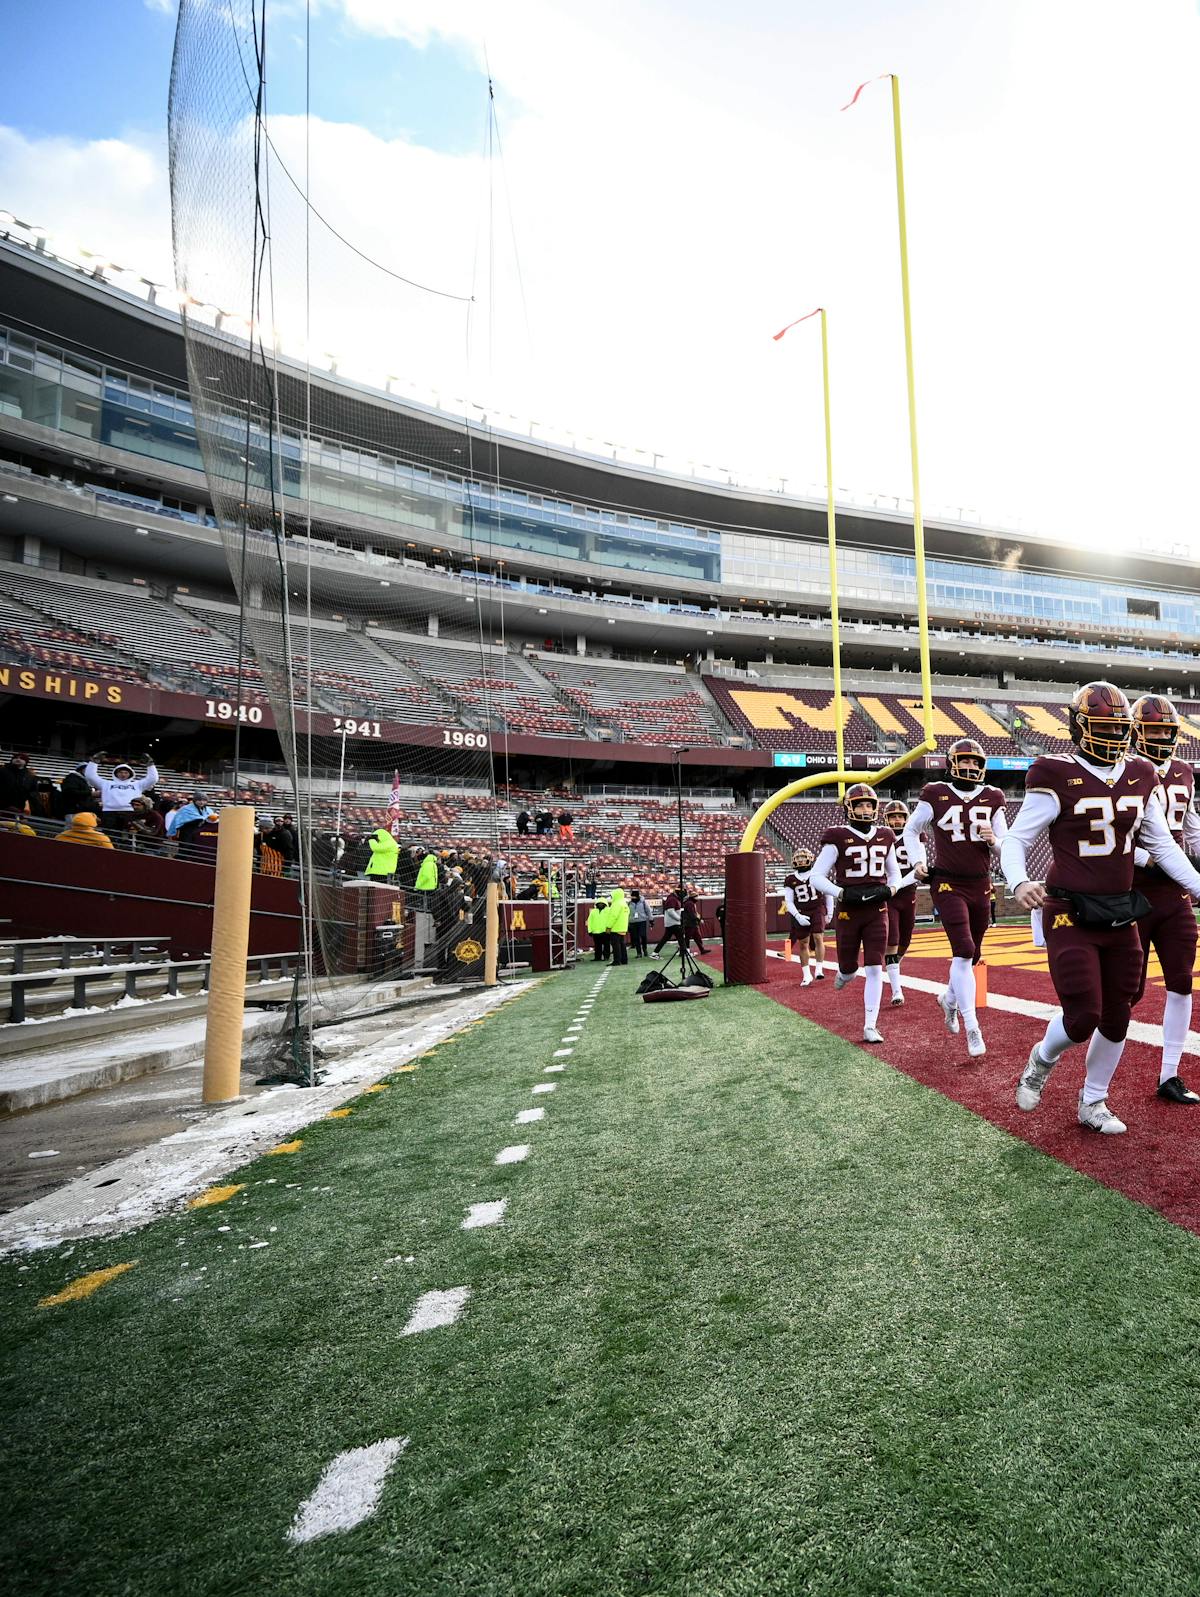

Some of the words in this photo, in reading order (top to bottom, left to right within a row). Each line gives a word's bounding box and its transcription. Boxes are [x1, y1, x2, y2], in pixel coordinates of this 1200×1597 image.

[974, 611, 1051, 627] UNIVERSITY
[1058, 620, 1073, 628] OF
[1079, 623, 1145, 636] MINNESOTA
[205, 700, 263, 724] 1940
[333, 718, 382, 738] 1941
[442, 730, 488, 748] 1960
[806, 756, 826, 764] OHIO
[827, 756, 851, 764] STE
[937, 805, 993, 843] 48
[1073, 796, 1145, 858] 37
[845, 845, 887, 878] 36
[794, 884, 818, 902] 81
